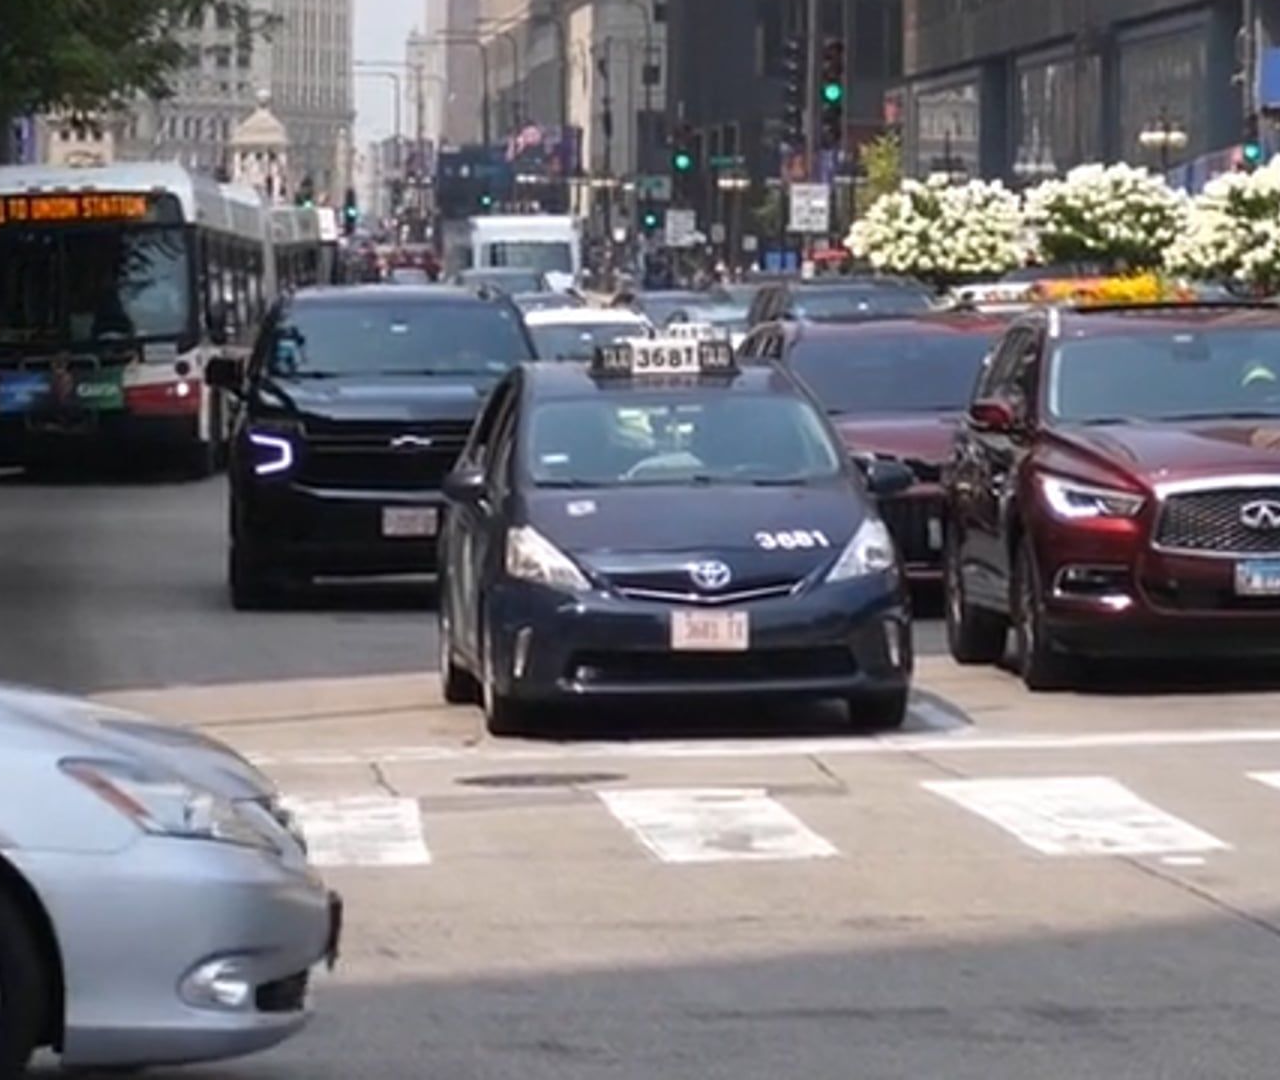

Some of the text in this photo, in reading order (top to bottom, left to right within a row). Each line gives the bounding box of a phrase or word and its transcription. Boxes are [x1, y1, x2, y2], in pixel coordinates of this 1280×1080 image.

[8, 196, 28, 220] TO
[30, 196, 78, 220] UNION
[81, 195, 147, 218] STATION
[636, 346, 695, 369] 3681
[754, 529, 830, 551] 3681
